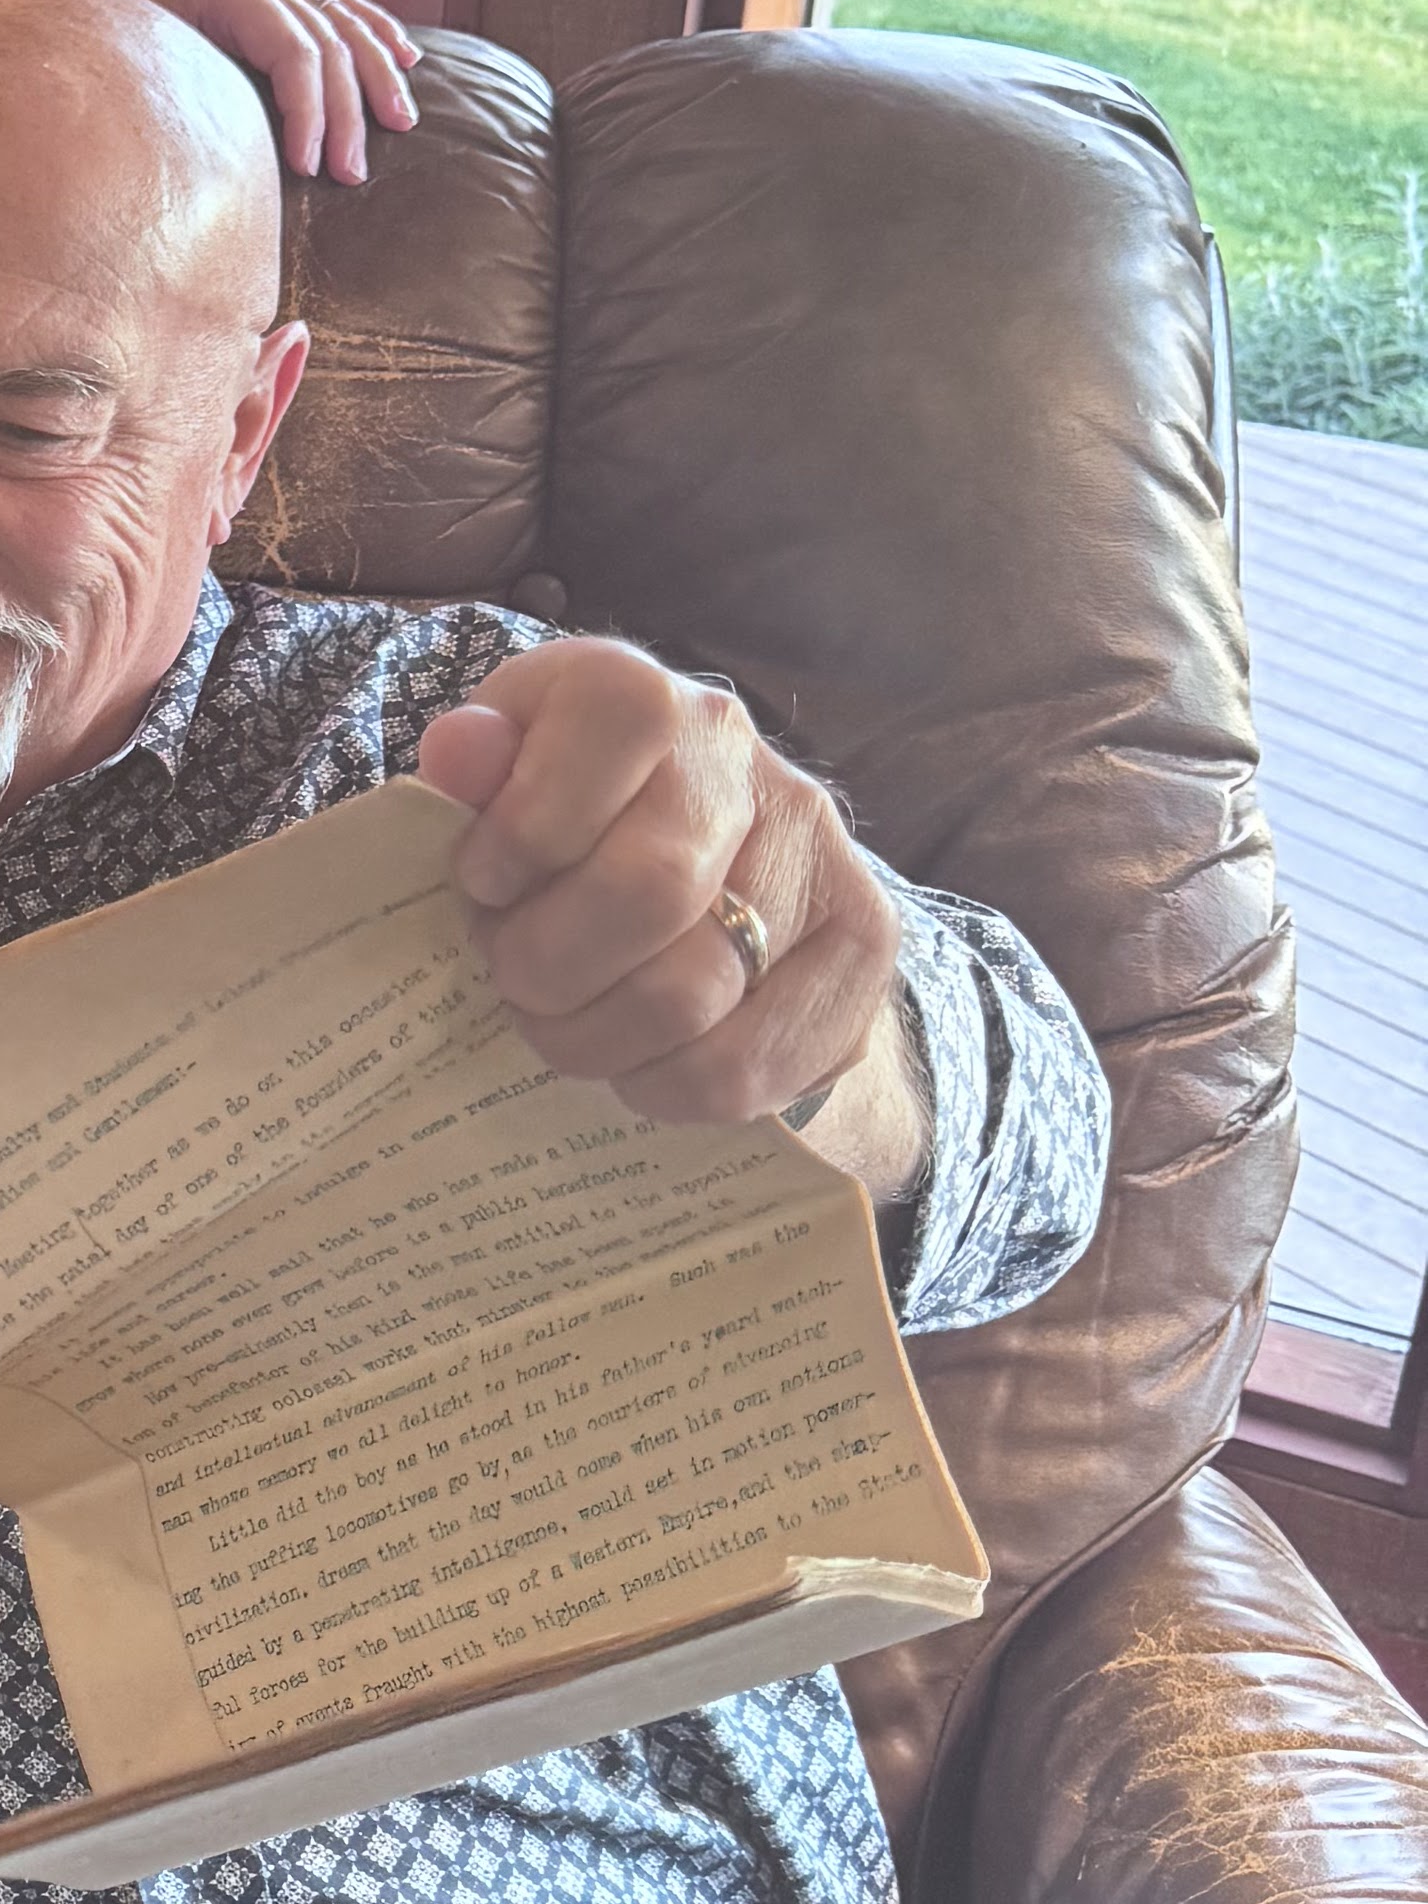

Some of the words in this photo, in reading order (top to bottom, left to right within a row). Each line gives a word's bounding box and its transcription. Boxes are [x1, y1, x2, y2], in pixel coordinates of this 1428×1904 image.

[19, 1284, 54, 1312] the
[57, 1245, 111, 1287] natal
[115, 1215, 150, 1244] day
[156, 1192, 179, 1217] of
[185, 1168, 218, 1195] one
[225, 1142, 244, 1168] of
[253, 1116, 290, 1144] the
[294, 1048, 383, 1118] founders
[389, 1022, 414, 1056] of
[418, 989, 467, 1024] this
[48, 1094, 80, 1123] and
[48, 1141, 82, 1172] and
[76, 1158, 158, 1221] together
[167, 1137, 190, 1160] as
[195, 1116, 220, 1136] we
[224, 1089, 250, 1117] do
[257, 1072, 283, 1094] on
[285, 1034, 333, 1069] this
[340, 968, 430, 1034] occasion
[432, 946, 459, 964] to
[294, 1159, 371, 1205] indulge
[377, 1142, 404, 1161] in
[411, 1113, 458, 1143] some
[122, 1353, 176, 1385] where
[181, 1327, 225, 1356] none
[231, 1301, 273, 1329] ever
[280, 1278, 326, 1309] grew
[328, 1245, 399, 1283] before
[406, 1228, 431, 1246] is
[460, 1193, 528, 1231] public
[532, 1160, 662, 1203] benefactor.
[130, 1331, 162, 1355] has
[168, 1304, 213, 1333] been
[216, 1277, 263, 1305] well
[267, 1250, 314, 1280] said
[318, 1225, 365, 1252] that
[367, 1211, 397, 1229] he
[403, 1191, 440, 1213] who
[443, 1172, 481, 1196] has
[489, 1152, 540, 1181] made
[546, 1145, 561, 1160] a
[565, 1125, 628, 1154] blade
[144, 1382, 178, 1407] How
[184, 1314, 318, 1389] pre-eminently
[324, 1293, 373, 1319] then
[376, 1277, 402, 1297] is
[407, 1257, 444, 1281] the
[449, 1244, 488, 1269] man
[494, 1213, 587, 1254] entitled
[589, 1205, 616, 1221] to
[623, 1190, 663, 1210] the
[161, 1411, 180, 1430] of
[188, 1364, 291, 1416] benefactor
[299, 1348, 320, 1369] of
[328, 1332, 364, 1357] his
[365, 1309, 417, 1339] kind
[420, 1285, 479, 1313] whose
[483, 1267, 533, 1294] life
[534, 1254, 577, 1277] has
[144, 1406, 267, 1464] constructing
[272, 1367, 357, 1412] colossal
[362, 1342, 418, 1374] works
[422, 1320, 471, 1346] that
[155, 1473, 185, 1498] and
[194, 1420, 313, 1484] intellectual
[322, 1371, 437, 1428] advancement
[447, 1355, 470, 1378] of
[480, 1340, 513, 1365] his
[525, 1309, 592, 1344] fellow
[600, 1293, 645, 1317] man.
[669, 1258, 717, 1289] Such
[725, 1243, 763, 1264] was
[773, 1220, 811, 1245] the
[161, 1510, 193, 1534] man
[198, 1485, 250, 1518] whose
[257, 1456, 318, 1492] memory
[327, 1442, 349, 1460] we
[358, 1423, 390, 1450] all
[398, 1390, 473, 1435] delight
[485, 1379, 505, 1395] to
[516, 1351, 581, 1385] honor.
[173, 1584, 204, 1609] ing
[209, 1570, 241, 1593] the
[248, 1536, 319, 1582] puffing
[326, 1487, 439, 1544] locomotives
[448, 1473, 469, 1496] go
[543, 1425, 578, 1450] the
[587, 1383, 678, 1432] couriers
[687, 1366, 710, 1391] of
[721, 1319, 829, 1377] advancing
[209, 1516, 268, 1554] Little
[275, 1496, 309, 1524] did
[315, 1480, 347, 1506] the
[356, 1464, 388, 1491] boy
[396, 1452, 418, 1472] as
[426, 1437, 450, 1459] he
[459, 1409, 514, 1446] stood
[525, 1398, 547, 1420] in
[554, 1380, 589, 1407] his
[601, 1339, 691, 1386] father's
[771, 1278, 844, 1315] watch-
[316, 1557, 371, 1589] dream
[378, 1532, 420, 1562] that
[428, 1517, 461, 1542] the
[469, 1499, 501, 1525] day
[510, 1469, 568, 1505] would
[577, 1448, 622, 1479] come
[630, 1427, 678, 1457] when
[685, 1407, 724, 1437] his
[734, 1392, 771, 1414] own
[780, 1348, 865, 1395] actions
[196, 1648, 256, 1689] guided
[264, 1635, 283, 1657] by
[292, 1628, 304, 1643] a
[311, 1577, 423, 1639] penetrating
[432, 1520, 568, 1585] intelligence,
[578, 1485, 635, 1522] would
[645, 1469, 679, 1496] set
[691, 1454, 716, 1477] in
[723, 1421, 797, 1465] motion
[803, 1391, 877, 1434] power-
[213, 1695, 242, 1721] ful
[249, 1670, 309, 1706] forces
[317, 1653, 347, 1678] for
[356, 1636, 388, 1660] the
[394, 1596, 480, 1645] building
[486, 1586, 511, 1608] up
[519, 1567, 542, 1593] of
[551, 1565, 564, 1582] a
[569, 1530, 651, 1572] Western
[784, 1454, 821, 1481] the
[831, 1429, 891, 1465] shap-
[295, 1696, 354, 1728] events
[362, 1662, 433, 1705] fraught
[441, 1639, 487, 1671] with
[493, 1625, 527, 1650] the
[534, 1587, 611, 1633] highest
[620, 1527, 768, 1601] possibilities
[777, 1511, 803, 1533] to
[811, 1490, 850, 1517] the
[858, 1460, 923, 1495] State
